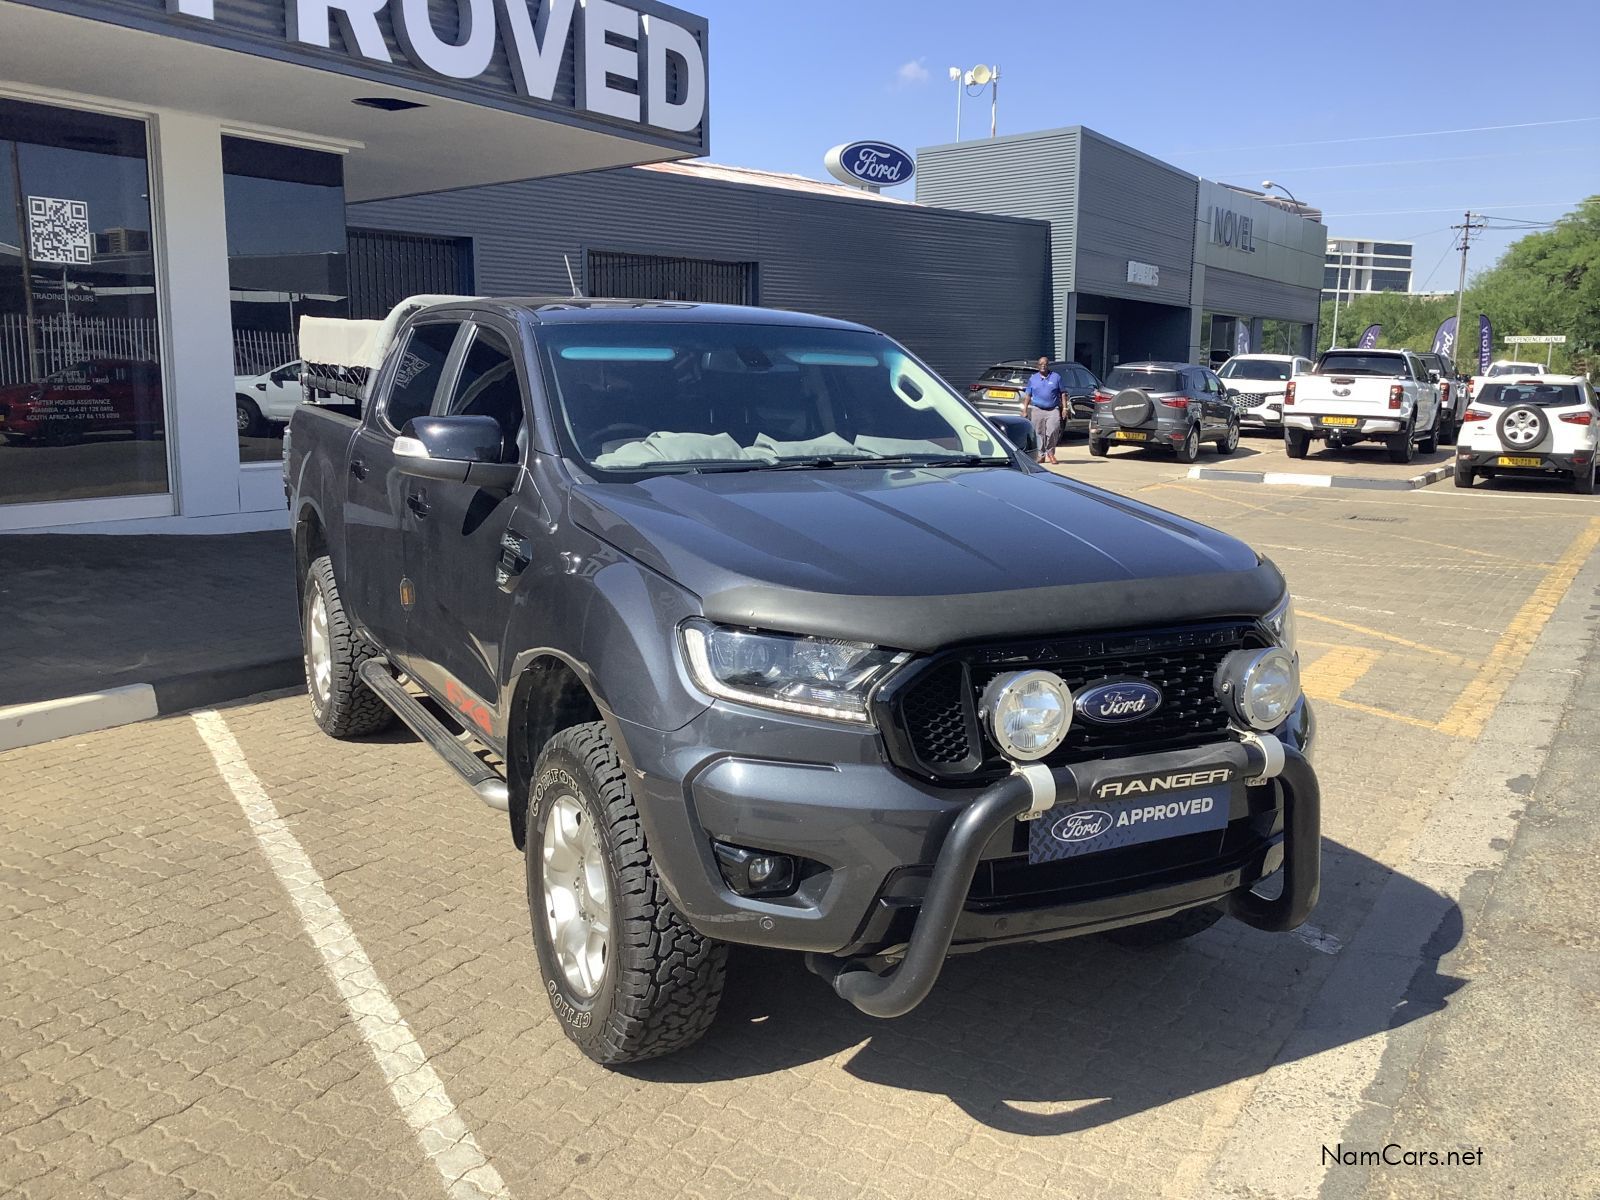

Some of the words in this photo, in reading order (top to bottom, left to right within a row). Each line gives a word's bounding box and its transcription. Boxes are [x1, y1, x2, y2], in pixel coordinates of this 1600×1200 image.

[178, 0, 705, 132] ROVED
[854, 148, 902, 180] Ford
[1210, 205, 1256, 253] NOVEL
[32, 292, 66, 301] TRADING
[69, 293, 94, 302] HOURS
[1101, 690, 1146, 715] Ford
[1100, 769, 1230, 798] RANGER
[1062, 814, 1102, 839] Ford
[1116, 797, 1214, 828] APPROVED
[548, 980, 591, 1028] CF1100
